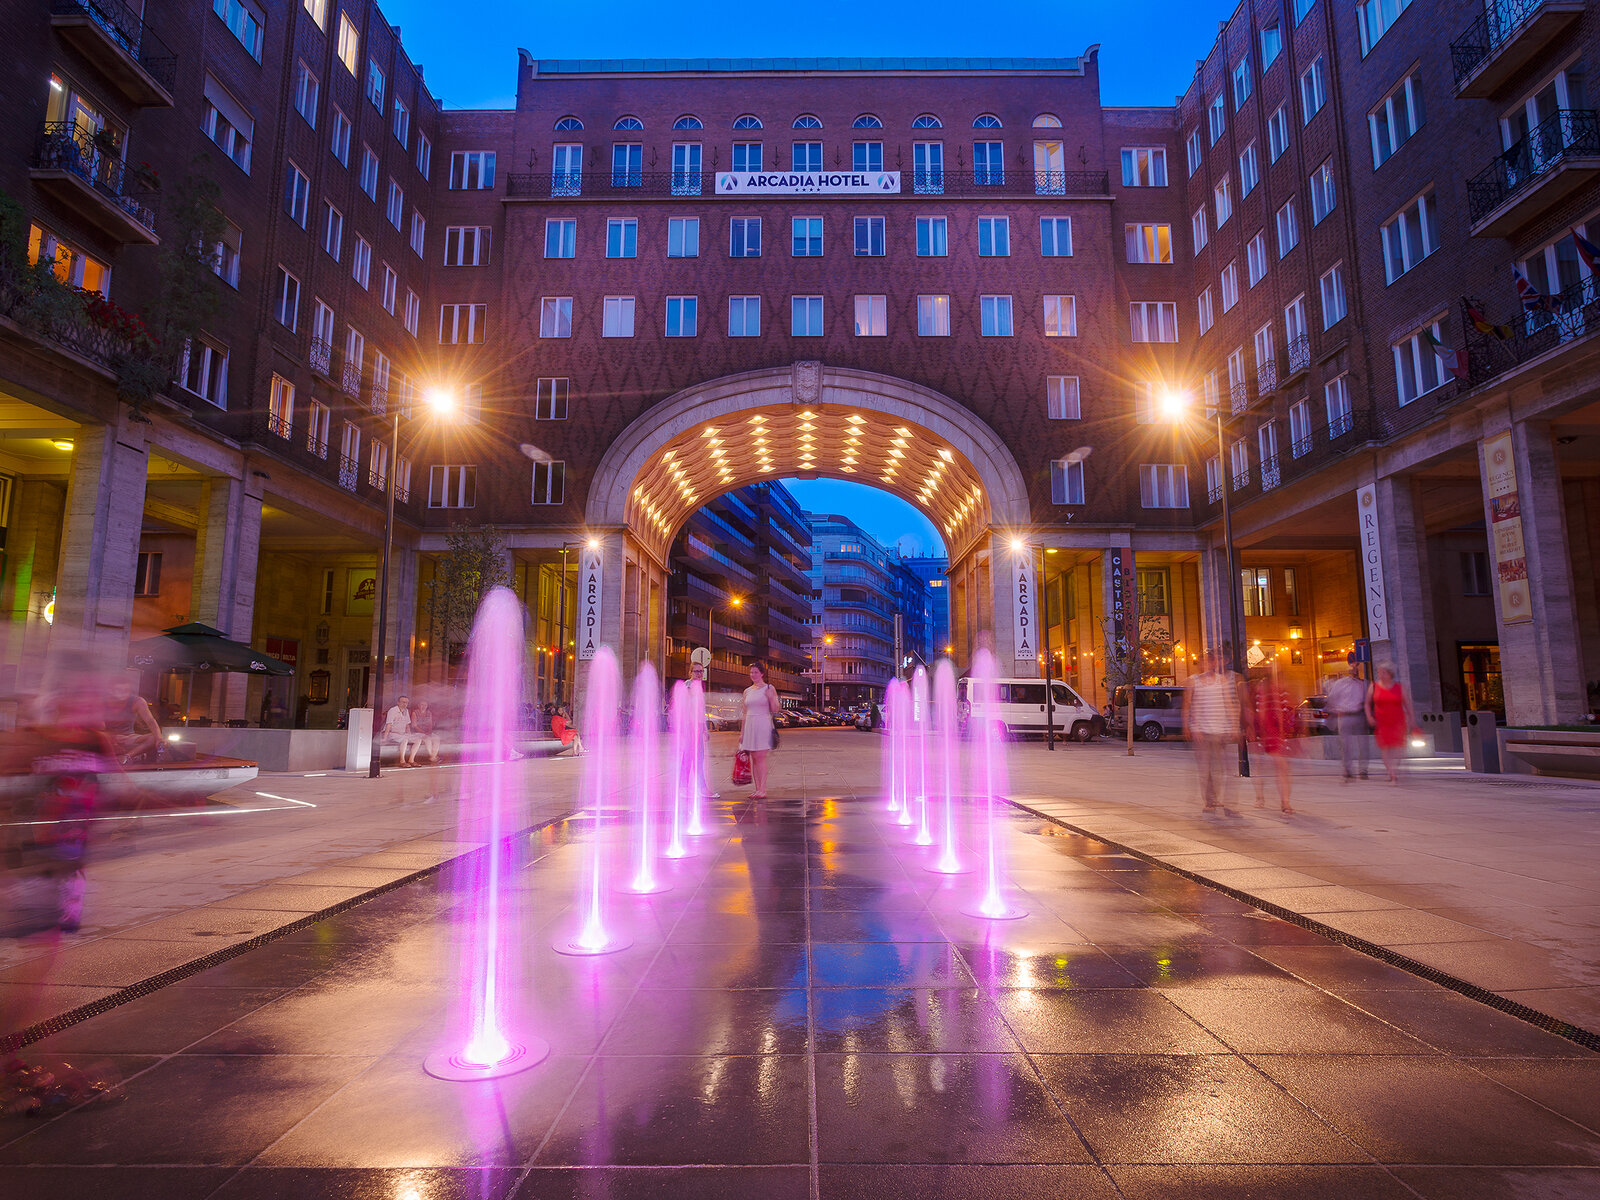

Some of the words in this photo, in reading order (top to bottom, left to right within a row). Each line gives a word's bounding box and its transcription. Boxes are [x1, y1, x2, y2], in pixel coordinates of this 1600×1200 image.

[747, 175, 813, 187] ARCADIA
[819, 175, 870, 187] HOTEL
[586, 573, 597, 649] ARCADIA
[1018, 573, 1030, 649] ARCADIA
[1364, 514, 1382, 637] REGENCY
